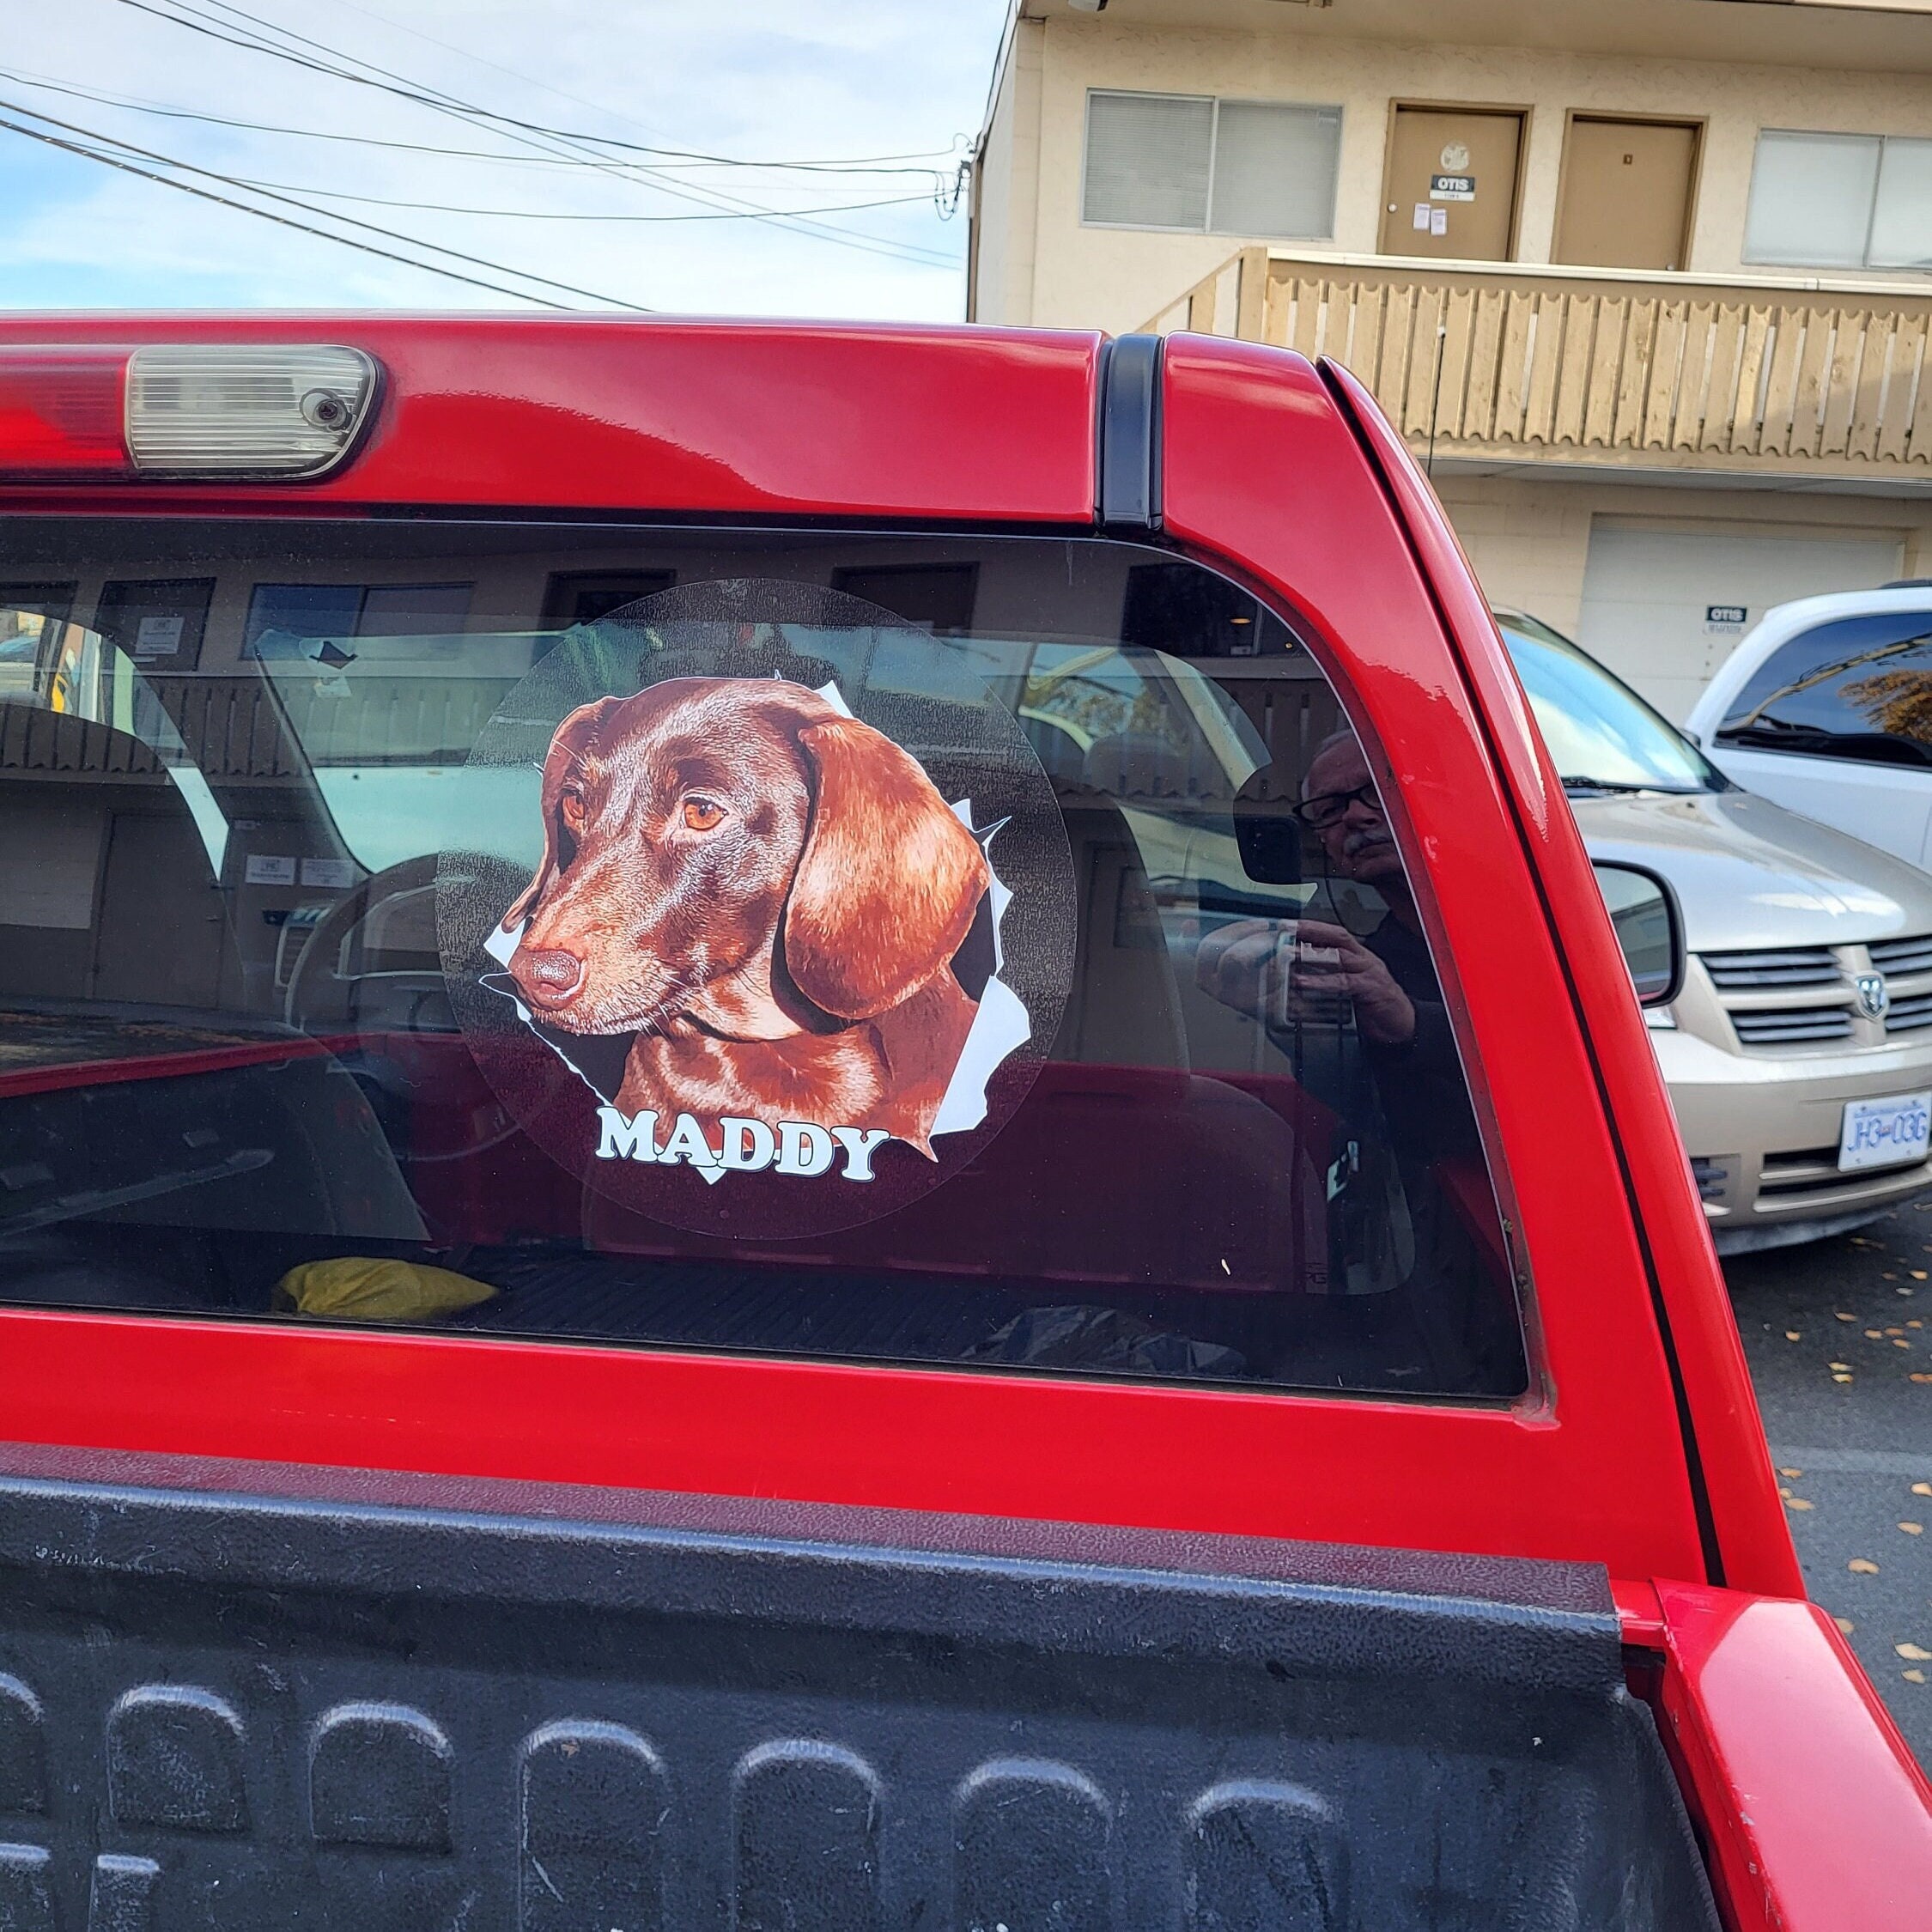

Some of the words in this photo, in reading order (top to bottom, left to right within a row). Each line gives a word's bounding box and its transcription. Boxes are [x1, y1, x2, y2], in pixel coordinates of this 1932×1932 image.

[1437, 177, 1469, 191] OTIS
[1710, 607, 1744, 621] OTIS
[595, 1105, 890, 1183] MADDY
